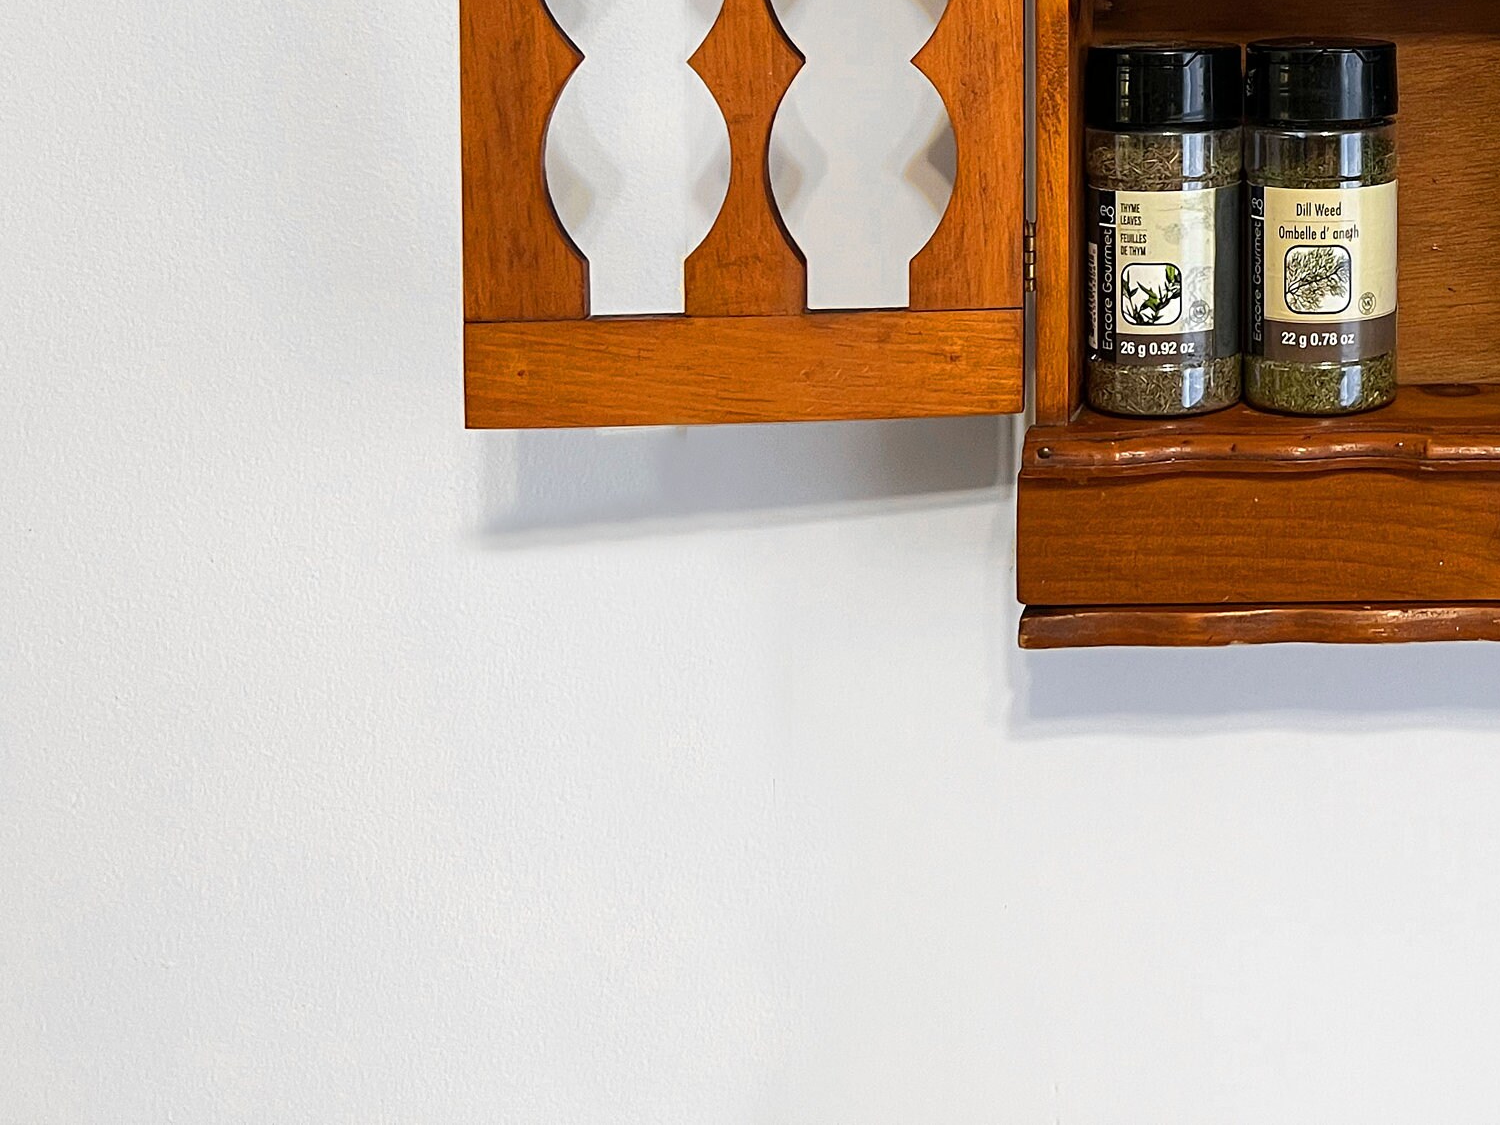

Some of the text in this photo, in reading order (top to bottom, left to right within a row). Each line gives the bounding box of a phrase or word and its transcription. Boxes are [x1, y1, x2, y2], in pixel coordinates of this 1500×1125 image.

[1120, 203, 1140, 213] THYME
[1296, 202, 1342, 216] Dill Weed
[1120, 215, 1142, 226] LEAVES
[1120, 233, 1147, 243] FEUILLES
[1279, 225, 1316, 240] Ombelle
[1120, 246, 1146, 256] DE THYM
[1253, 221, 1263, 342] Encore Gourmet
[1102, 229, 1113, 350] Encore Gourmet
[1281, 332, 1355, 348] 22 g 0.78 oz
[1120, 341, 1195, 358] 26 g 0.92 oz
